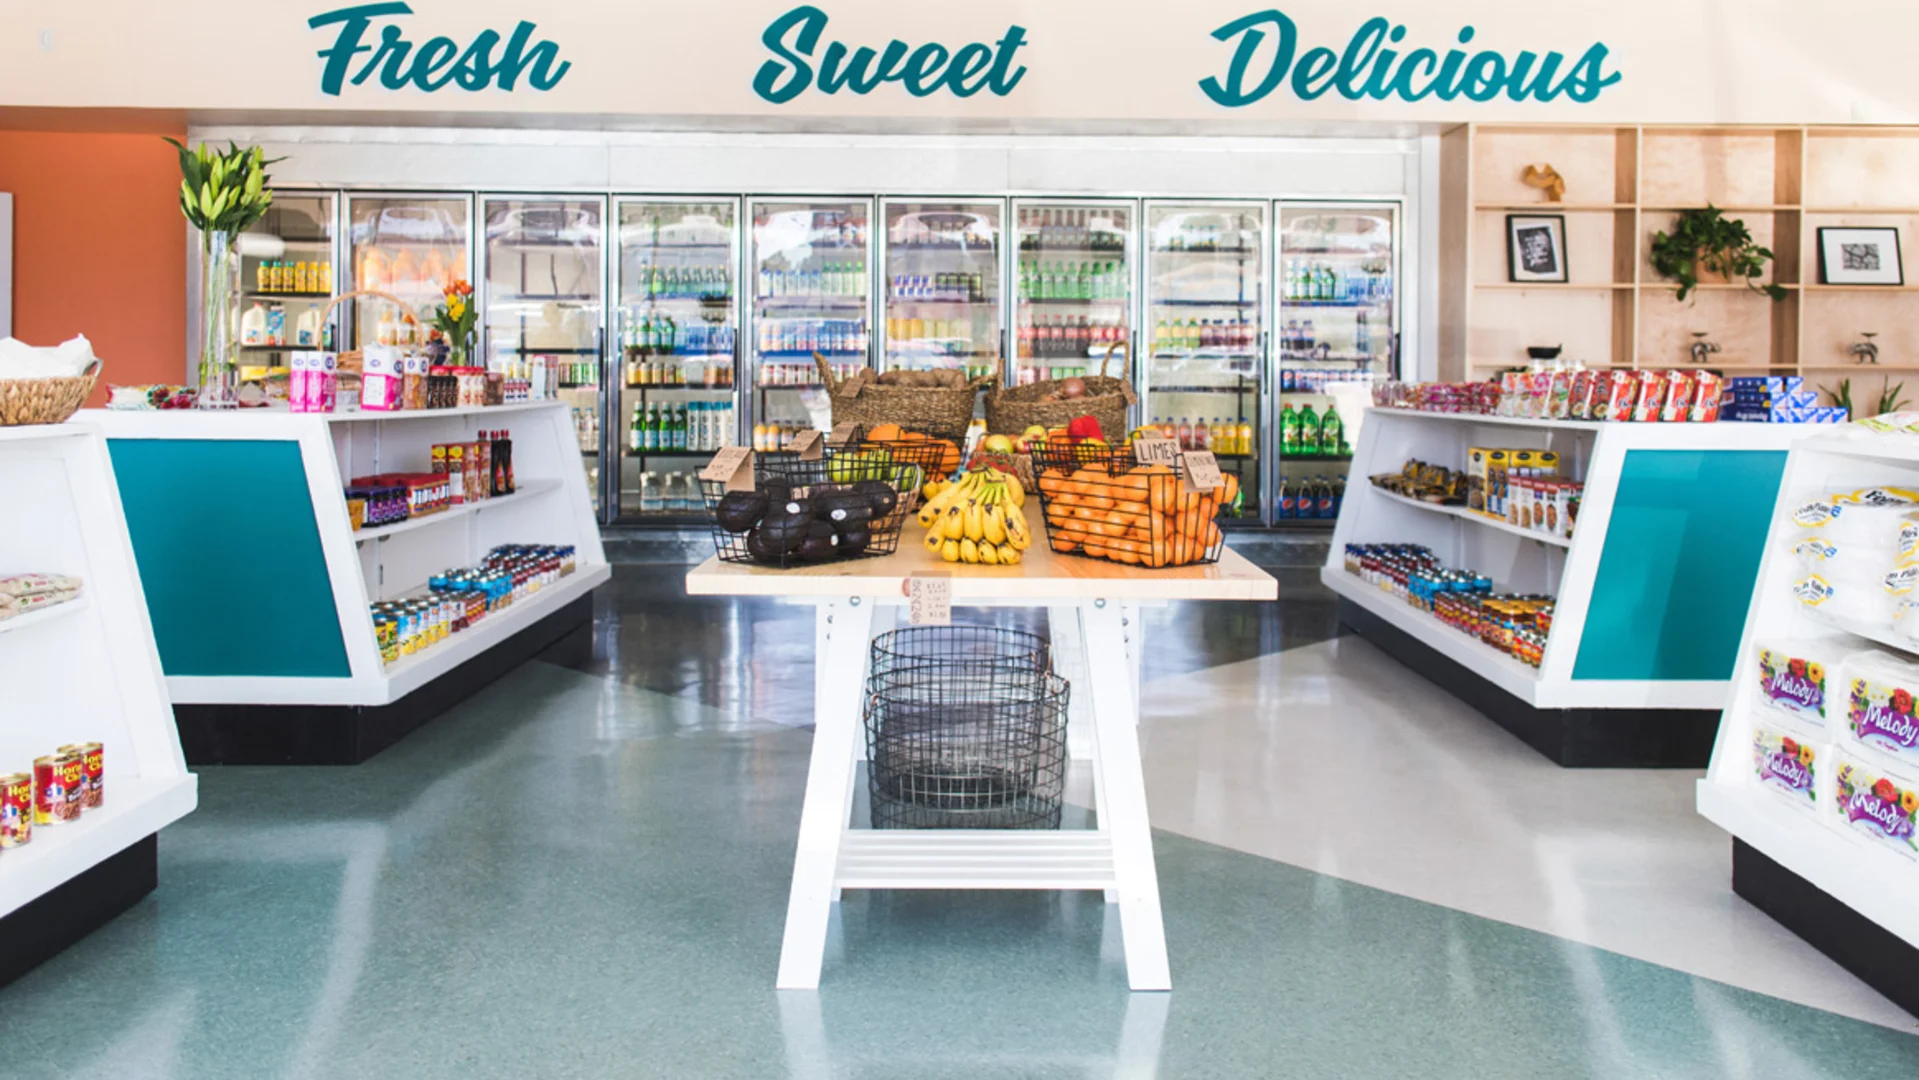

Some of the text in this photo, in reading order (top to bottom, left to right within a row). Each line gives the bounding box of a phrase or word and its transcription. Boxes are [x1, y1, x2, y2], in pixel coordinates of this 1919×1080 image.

[308, 0, 1622, 107] Fresh Sweet Delicious
[1139, 442, 1177, 461] LIMES
[1771, 671, 1813, 704] Melody
[1863, 705, 1918, 745] Melody
[1764, 751, 1803, 786] Melody
[1850, 792, 1903, 833] Melody
